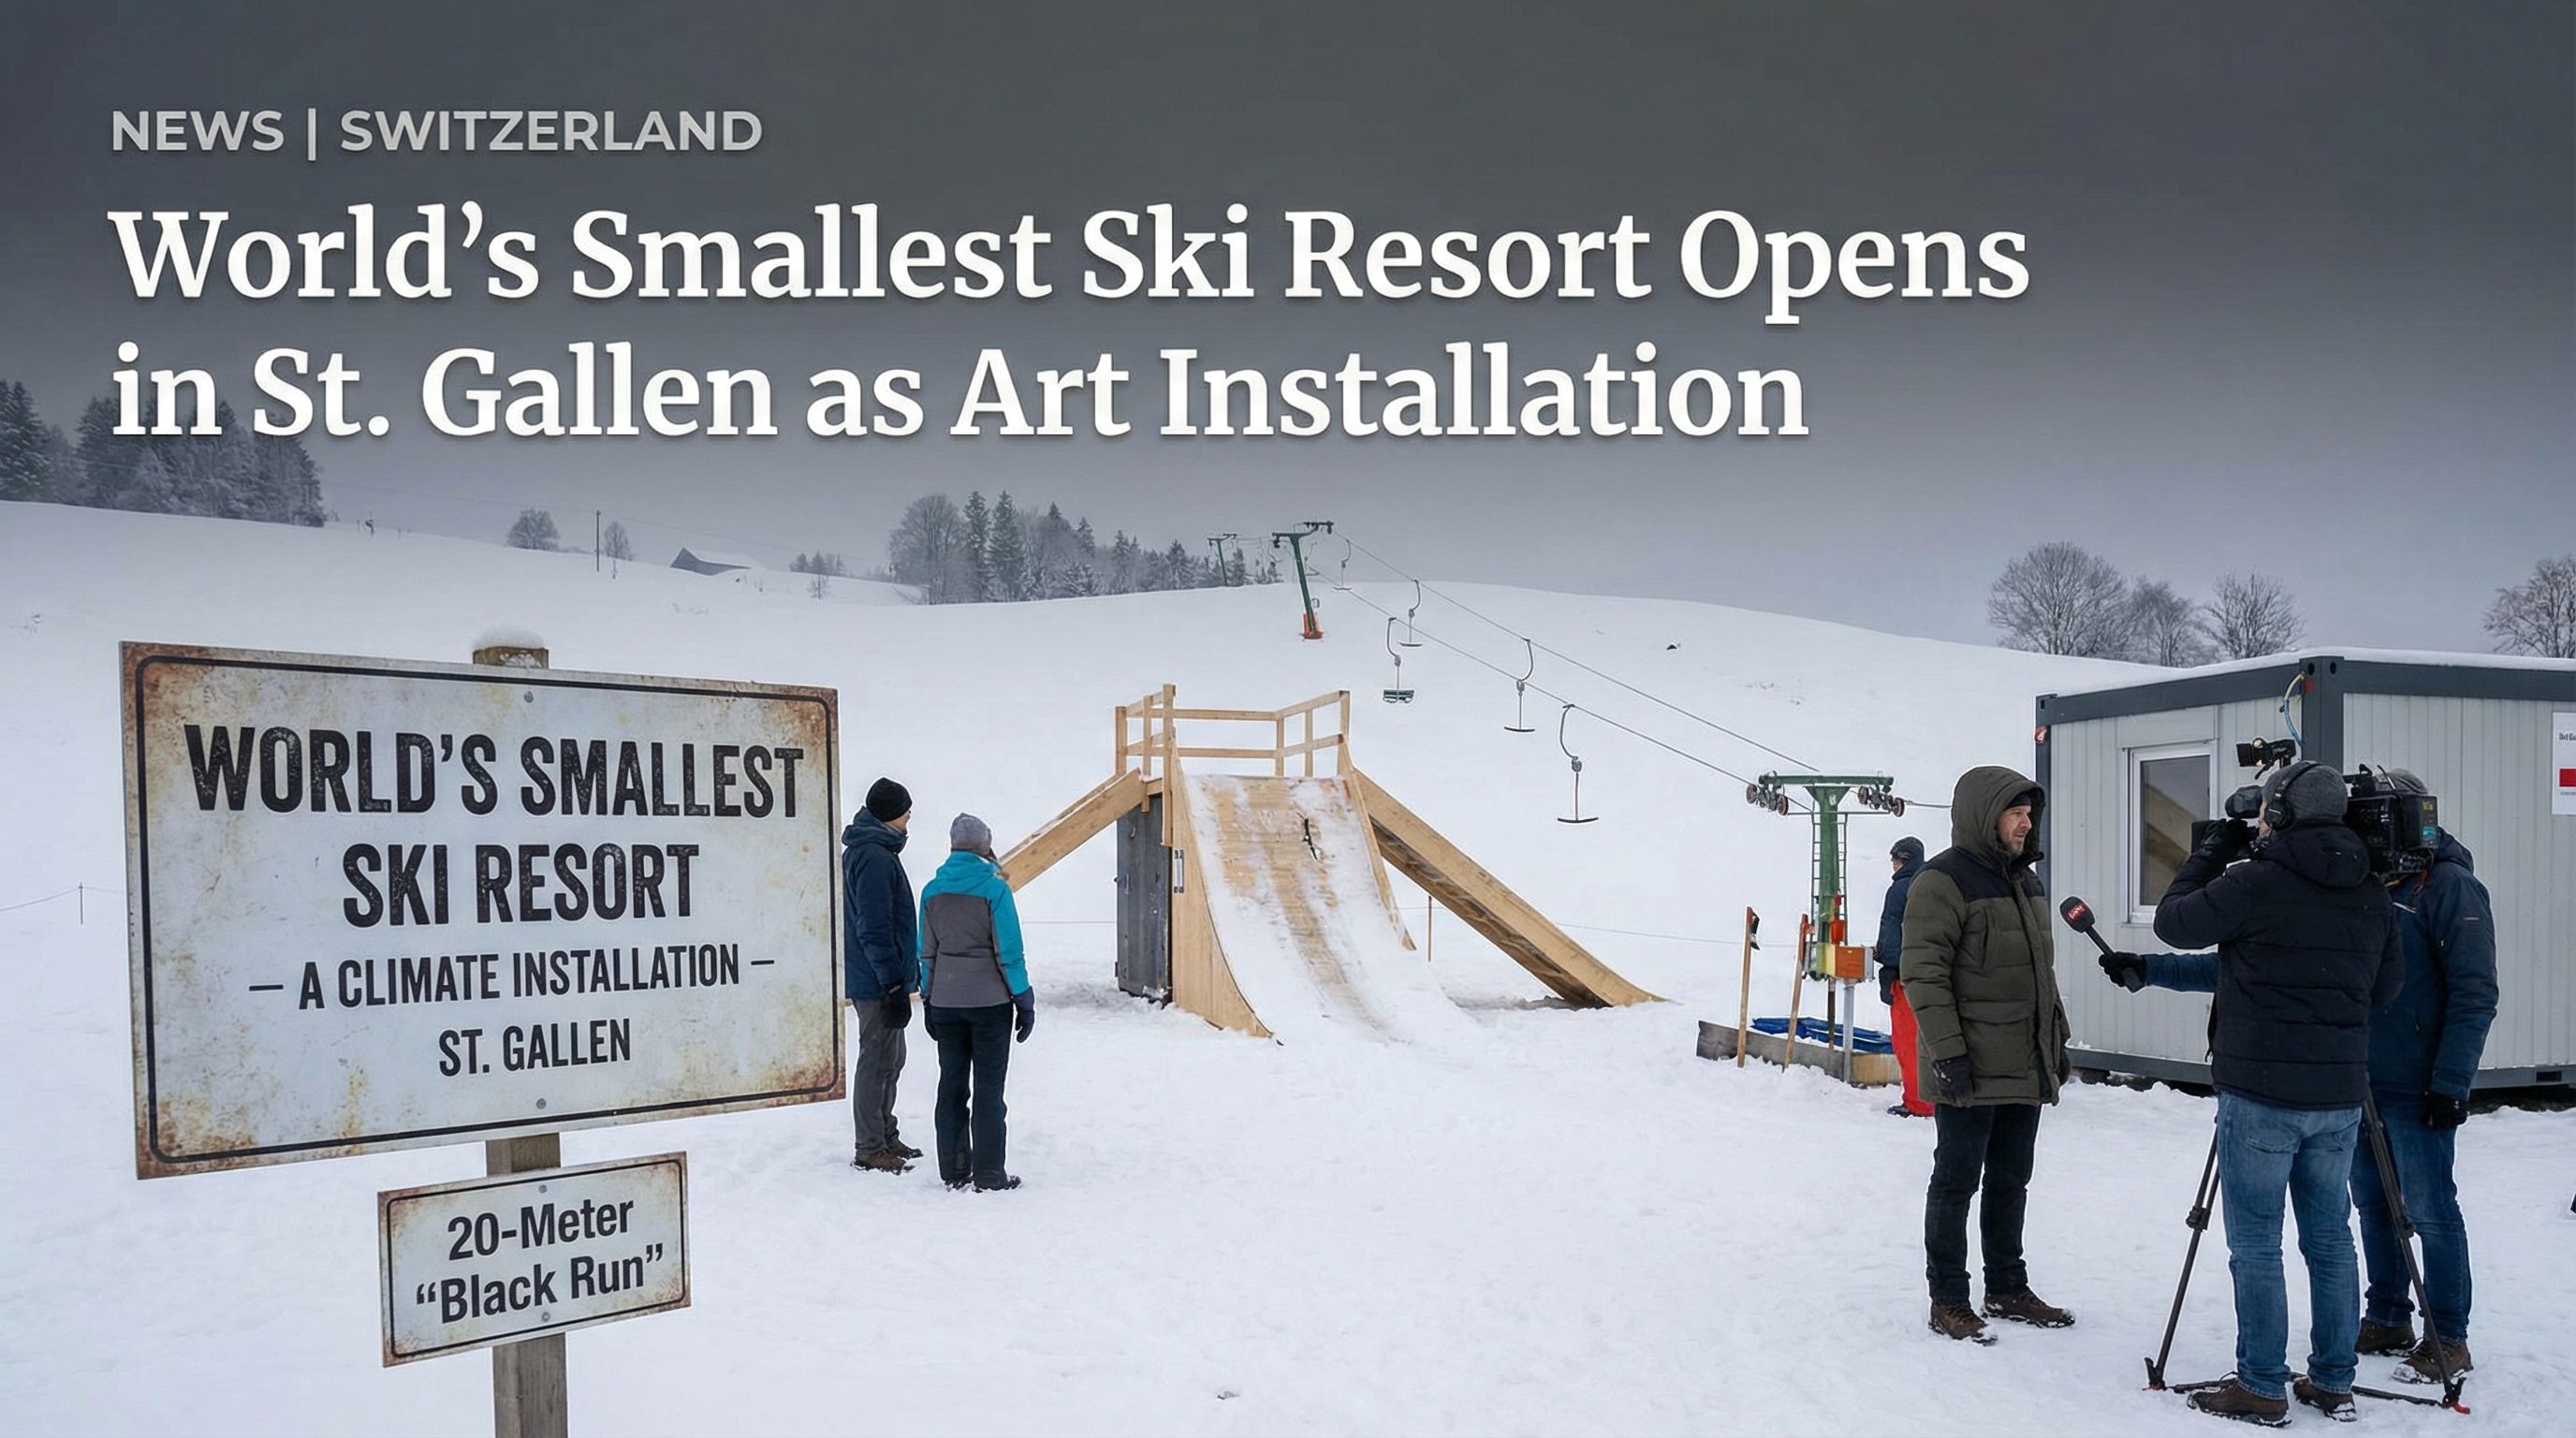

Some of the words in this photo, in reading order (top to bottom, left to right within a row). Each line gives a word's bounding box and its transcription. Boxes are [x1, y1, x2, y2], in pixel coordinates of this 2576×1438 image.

[183, 723, 499, 816] WORLD’S
[520, 735, 805, 819] SMALLEST
[342, 842, 450, 929] SKI
[474, 842, 700, 924] RESORT
[298, 961, 326, 1011] A
[337, 951, 501, 1009] CLIMATE
[512, 942, 740, 999] INSTALLATION
[437, 1027, 491, 1078] ST.
[502, 1017, 632, 1073] GALLEN
[446, 1197, 635, 1262] 20-Meter
[415, 1262, 559, 1325] “Black
[569, 1241, 665, 1300] Run”
